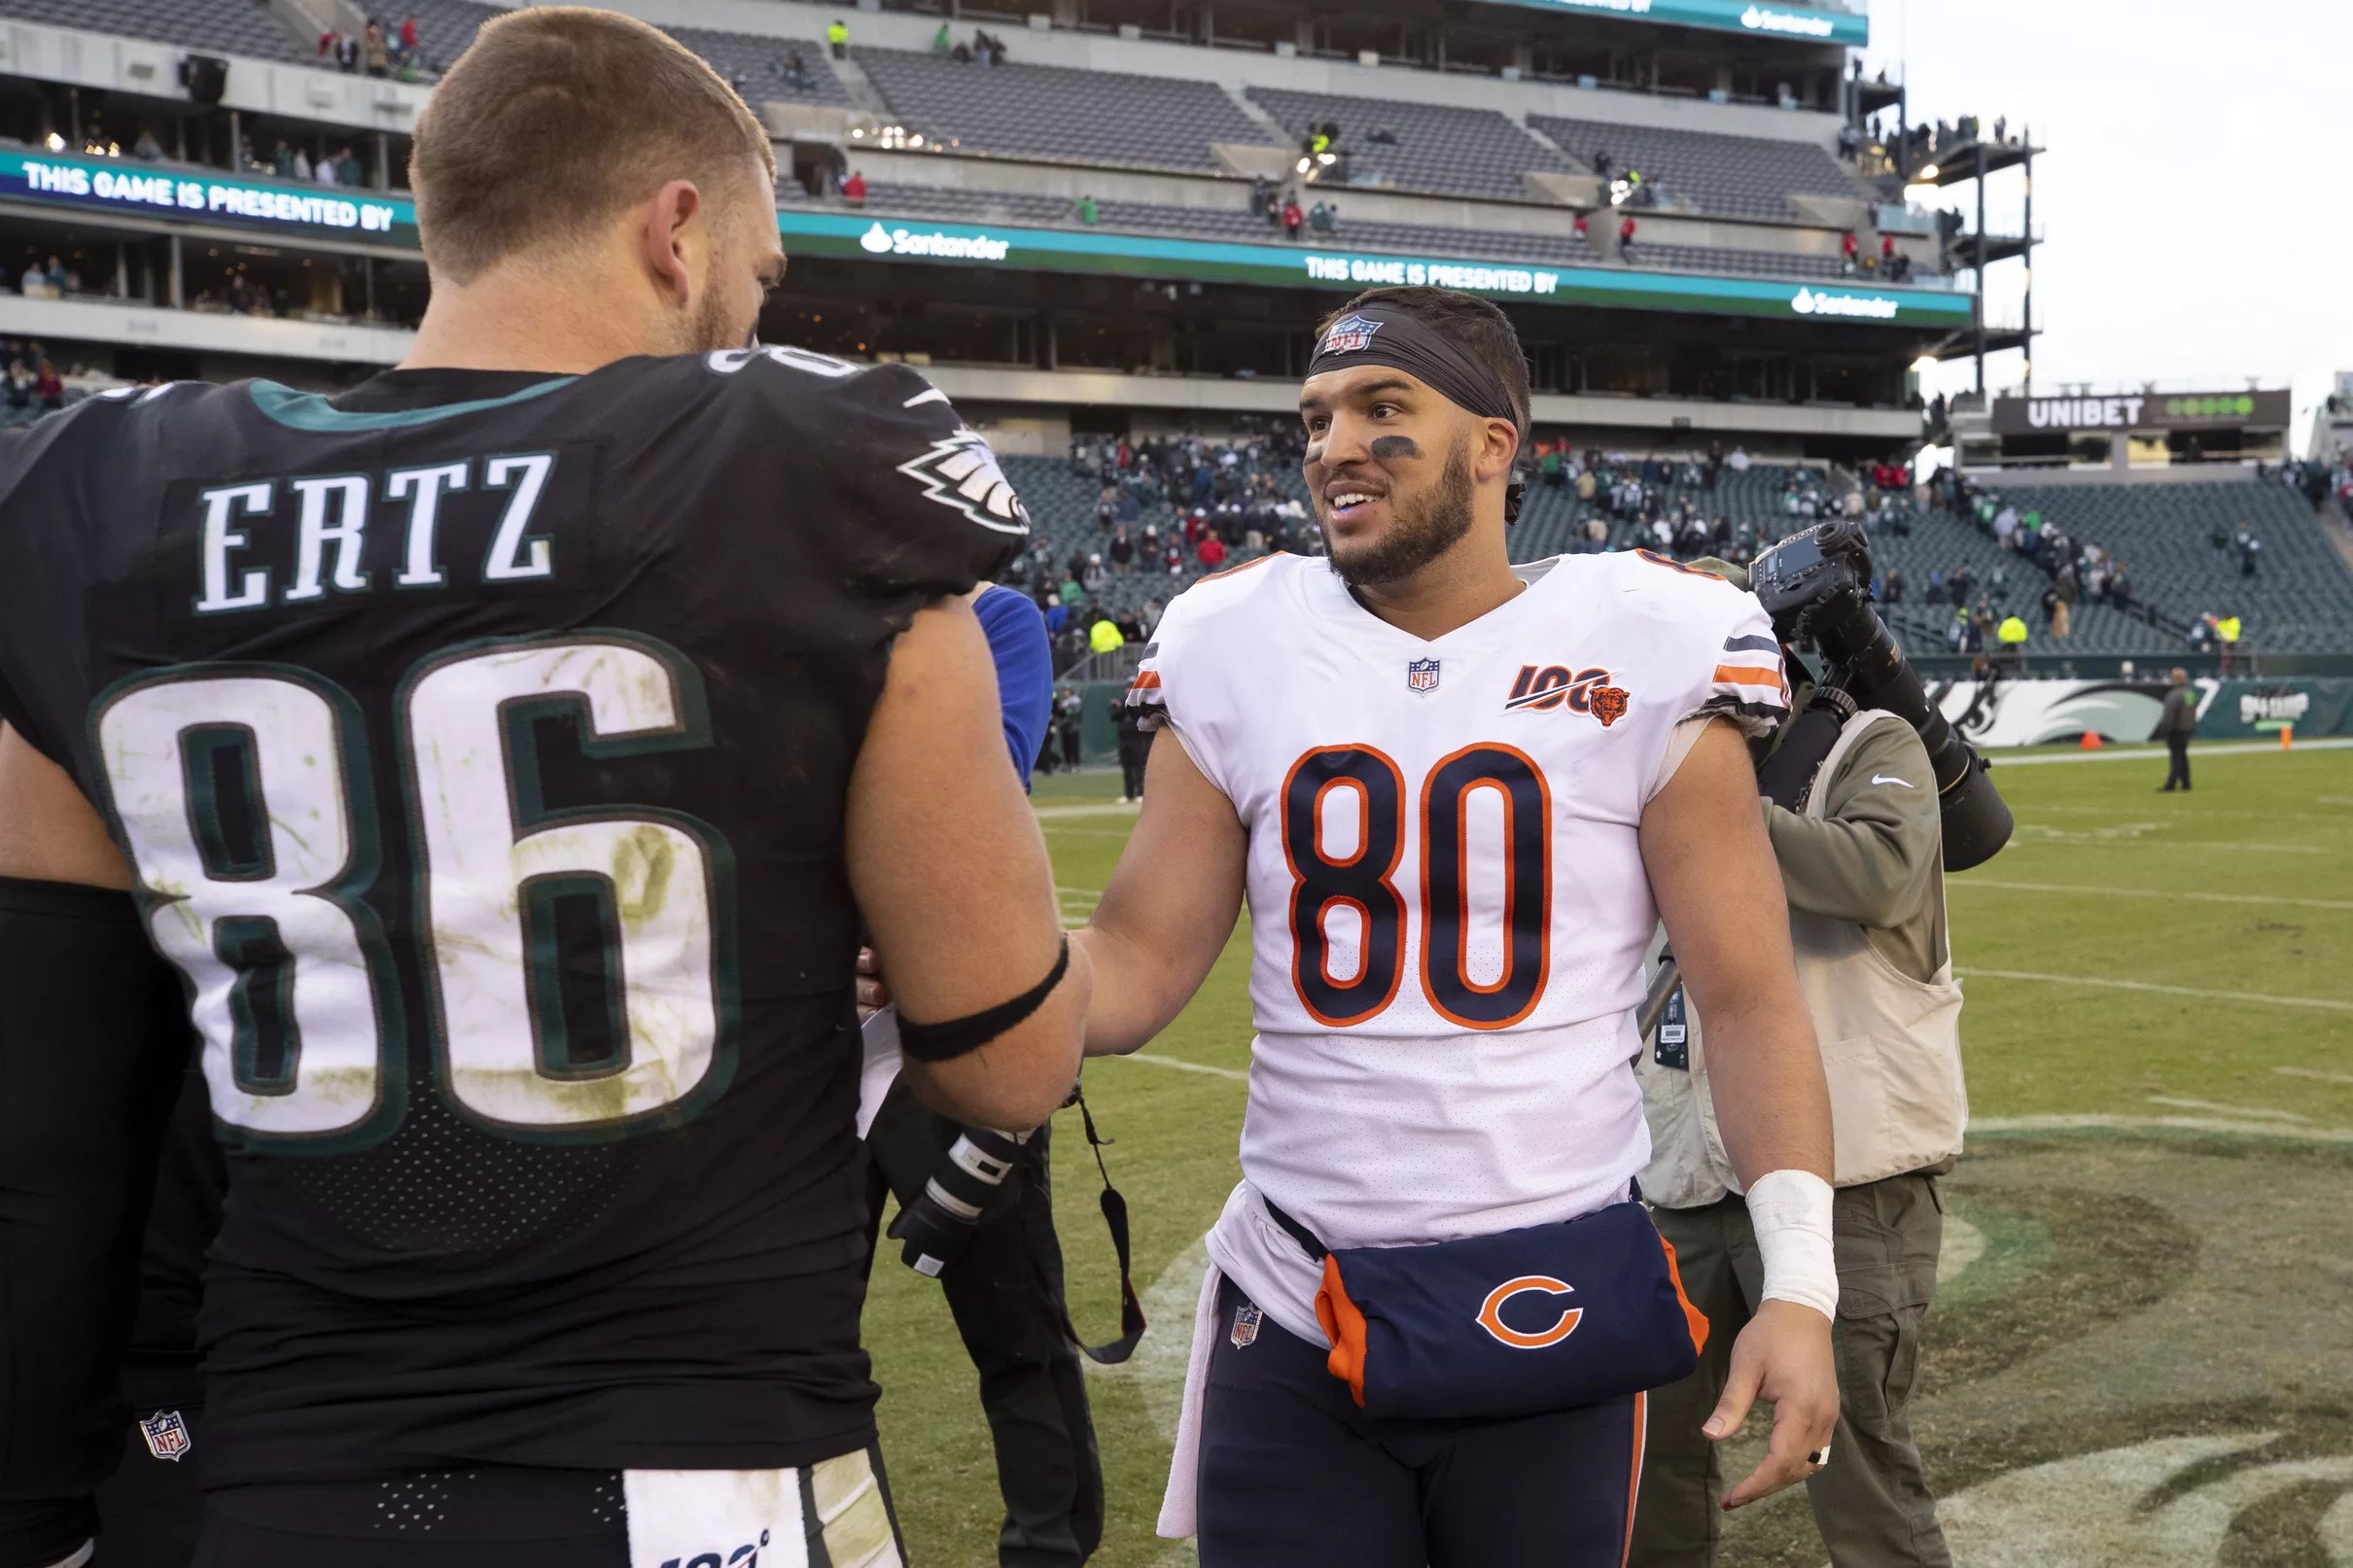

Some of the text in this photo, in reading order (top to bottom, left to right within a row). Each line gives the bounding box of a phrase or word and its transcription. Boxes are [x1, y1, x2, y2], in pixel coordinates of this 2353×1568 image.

[21, 161, 394, 232] THIS GAME IS PRESENTED BY
[892, 228, 1010, 261] Santander
[1305, 256, 1560, 295] THIS GAME IS PRESENTED BY
[1814, 292, 1899, 319] Santander
[1330, 332, 1364, 350] NFL
[2027, 397, 2145, 428] UNIBET
[194, 453, 554, 613] ERTZ
[1412, 672, 1436, 688] NFL
[90, 632, 739, 1151] 86
[1280, 742, 1553, 1030] 80
[1235, 1323, 1252, 1342] NFL
[154, 1430, 186, 1452] NFL
